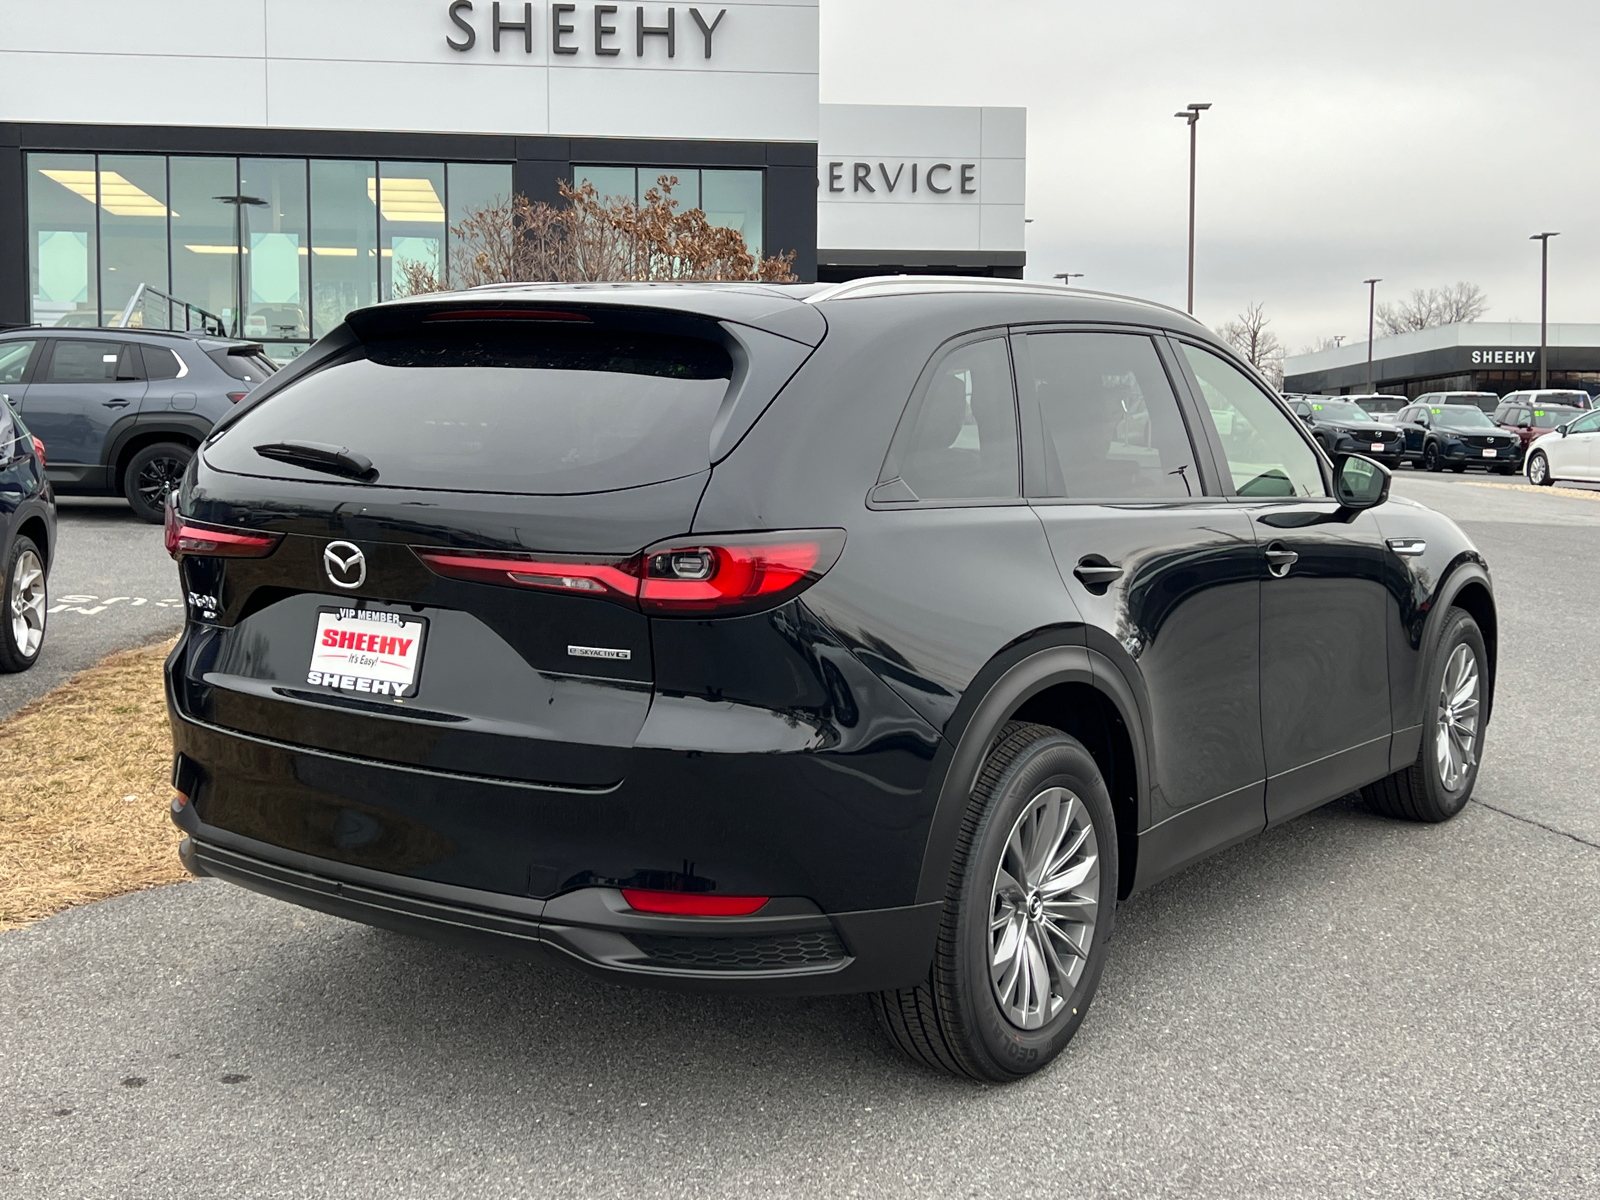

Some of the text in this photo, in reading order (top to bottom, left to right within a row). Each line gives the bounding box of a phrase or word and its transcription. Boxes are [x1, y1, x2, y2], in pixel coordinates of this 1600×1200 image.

[446, 0, 727, 59] SHEEHY
[816, 161, 977, 195] ERVICE
[1471, 350, 1536, 364] SHEEHY
[339, 607, 400, 624] VIP MEMBER
[321, 628, 414, 657] SHEEHY
[348, 653, 379, 669] It's Easy!
[306, 670, 410, 697] SHEEHY
